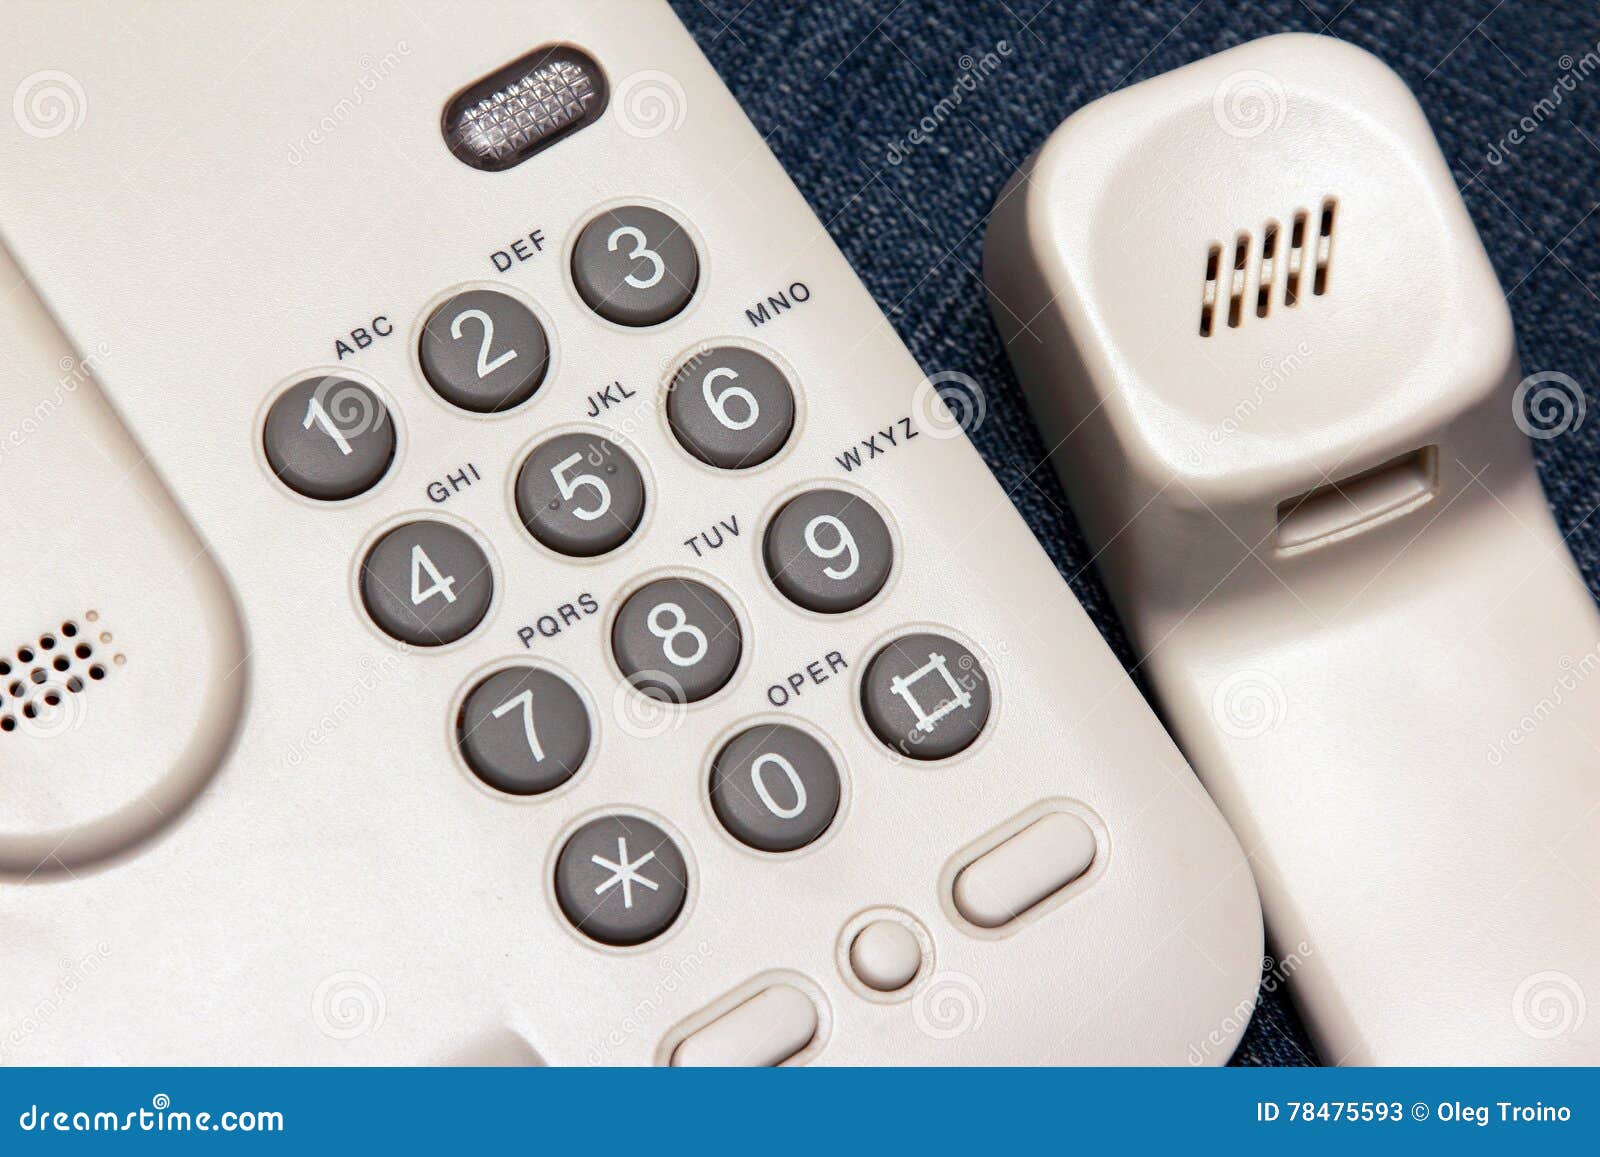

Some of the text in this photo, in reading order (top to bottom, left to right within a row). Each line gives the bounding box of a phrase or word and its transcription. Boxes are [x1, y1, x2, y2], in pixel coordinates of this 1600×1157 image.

[489, 228, 546, 273] DEF
[607, 226, 665, 289] 3
[745, 281, 811, 327] MNO
[334, 315, 393, 360] ABC
[450, 309, 519, 379] 2
[302, 397, 353, 456] 1
[586, 381, 637, 418] JKL
[702, 367, 760, 431] 6
[835, 417, 919, 473] WXYZ
[426, 463, 482, 504] GHI
[551, 451, 612, 521] 5
[684, 515, 740, 558] TUV
[804, 515, 860, 581] 9
[410, 544, 458, 606] 4
[516, 592, 600, 649] PQRS
[647, 602, 709, 668] 8
[767, 650, 849, 707] OPER
[491, 688, 546, 763] 7
[750, 752, 808, 820] 0
